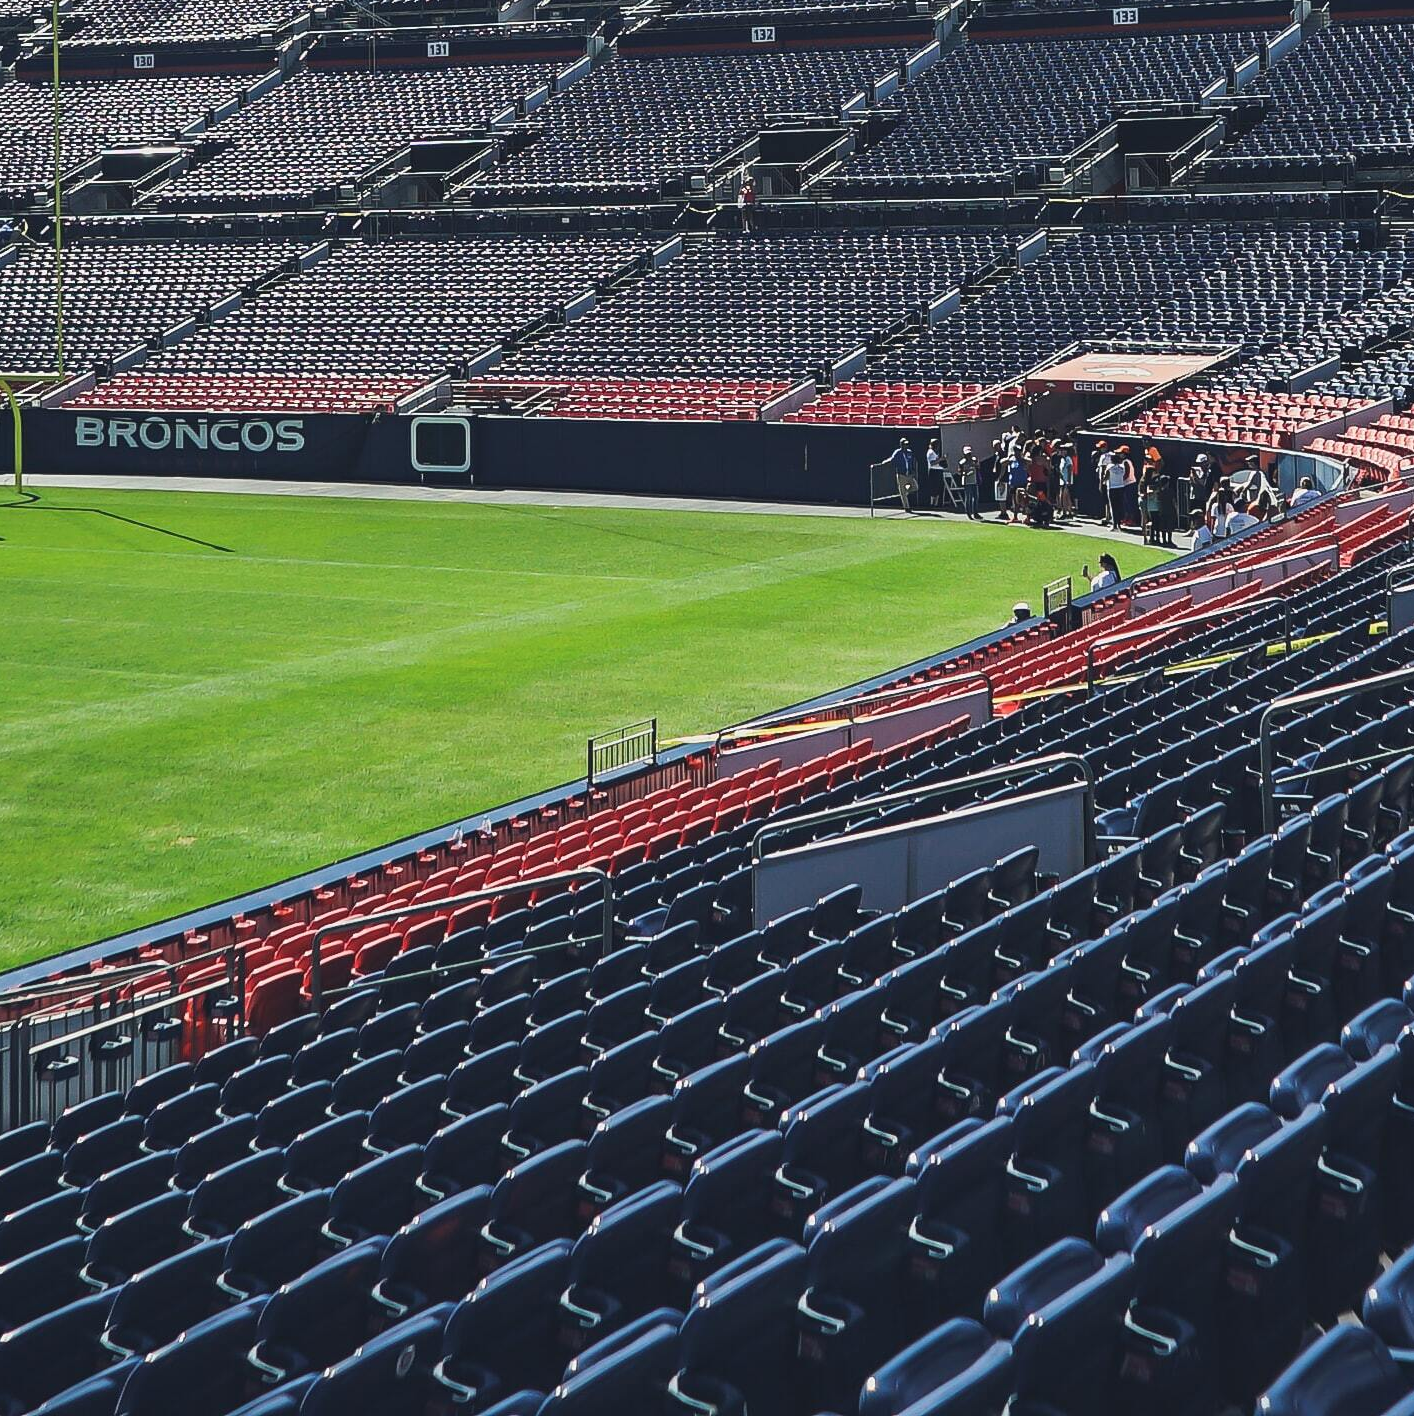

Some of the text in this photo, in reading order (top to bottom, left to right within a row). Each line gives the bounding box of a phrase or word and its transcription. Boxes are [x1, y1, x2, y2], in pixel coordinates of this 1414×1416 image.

[1115, 10, 1137, 23] 133
[754, 28, 774, 40] 132
[430, 44, 447, 55] 131
[135, 56, 153, 66] 130
[1073, 381, 1114, 392] GEICO
[75, 416, 305, 452] BRONCOS
